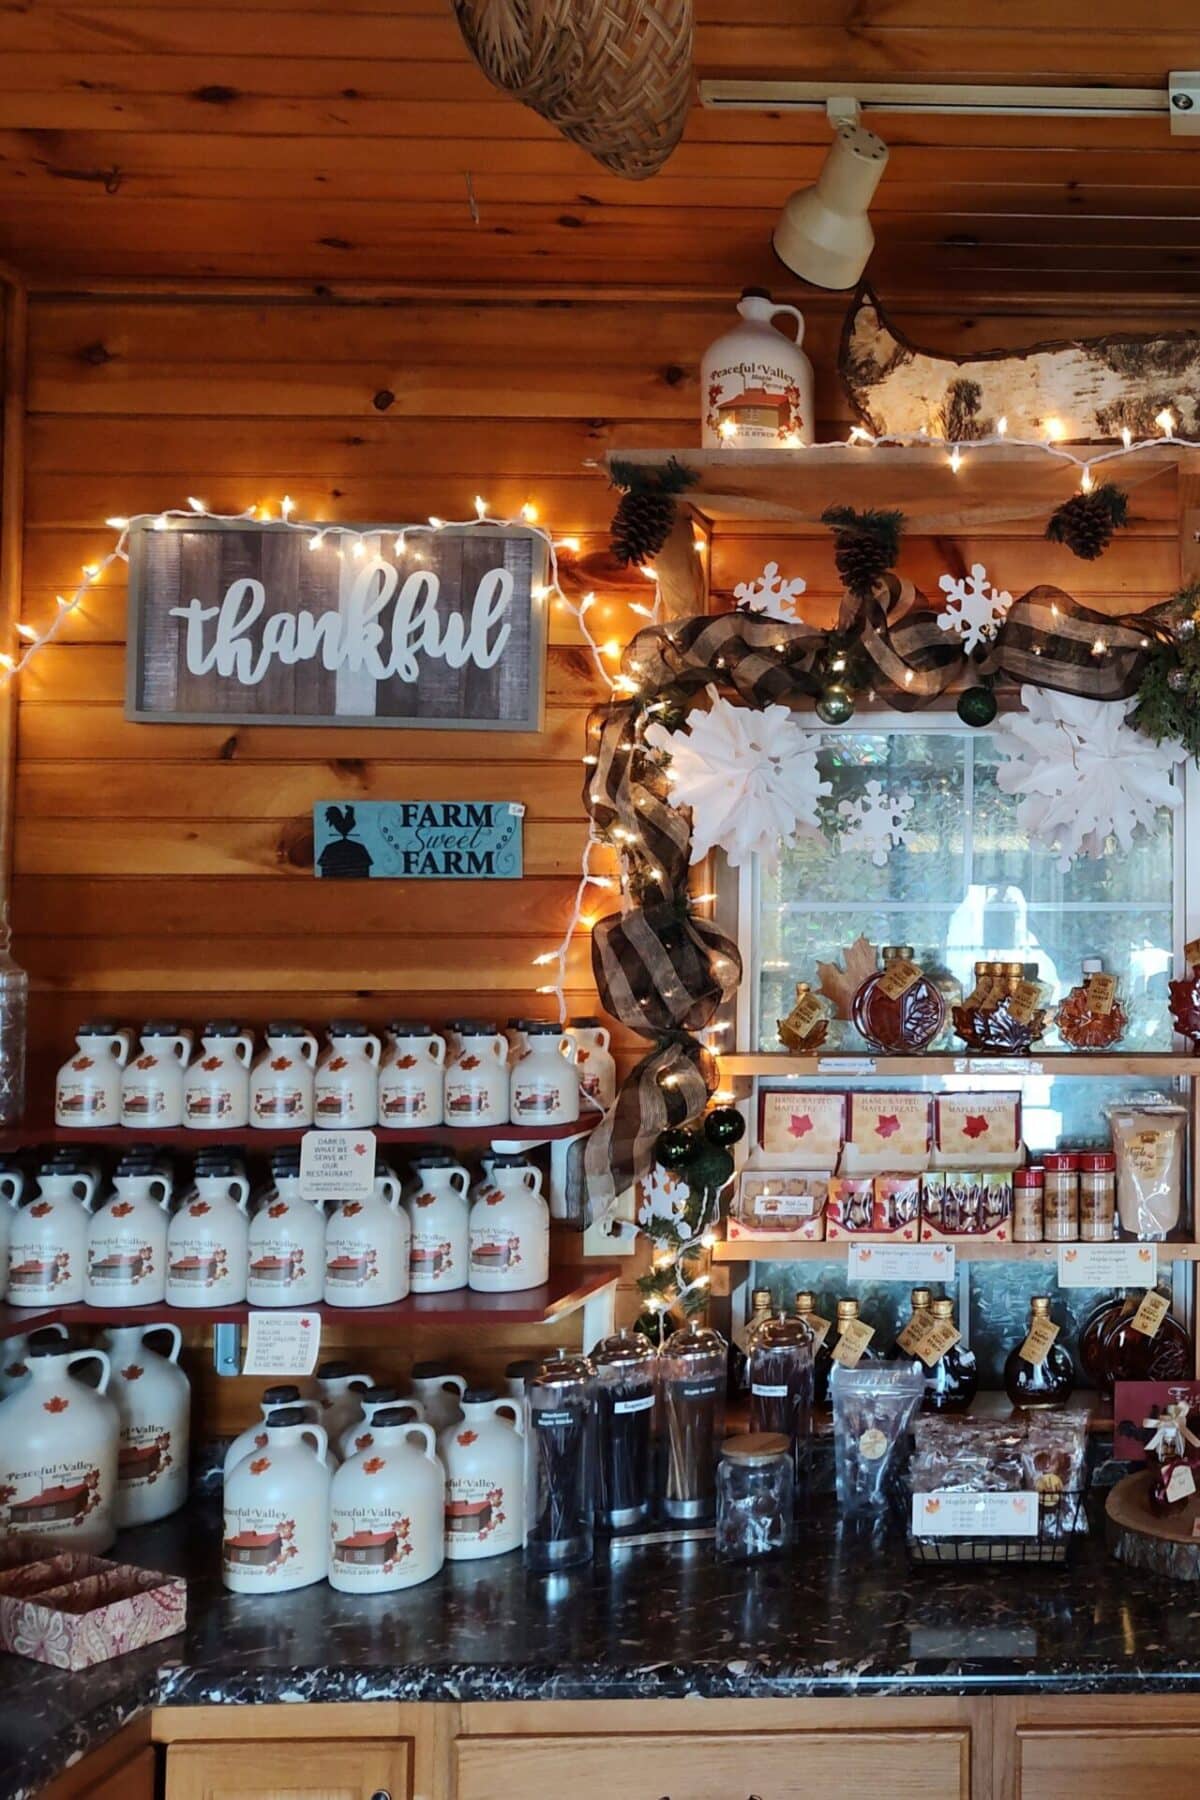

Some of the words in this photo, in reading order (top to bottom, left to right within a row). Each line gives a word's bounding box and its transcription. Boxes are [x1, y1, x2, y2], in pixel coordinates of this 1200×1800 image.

[710, 362, 756, 381] Peaceful
[757, 365, 796, 386] Valley
[169, 561, 514, 684] thankful
[400, 803, 495, 829] FARM
[404, 826, 493, 852] Sweet
[402, 851, 496, 875] FARM
[949, 1105, 976, 1113] MAPLE
[978, 1105, 1007, 1113] TREATS
[131, 1424, 164, 1434] Valley
[58, 1461, 95, 1472] Valley
[463, 1479, 496, 1489] Valley
[252, 1508, 289, 1519] Valley
[366, 1507, 402, 1519] Valley
